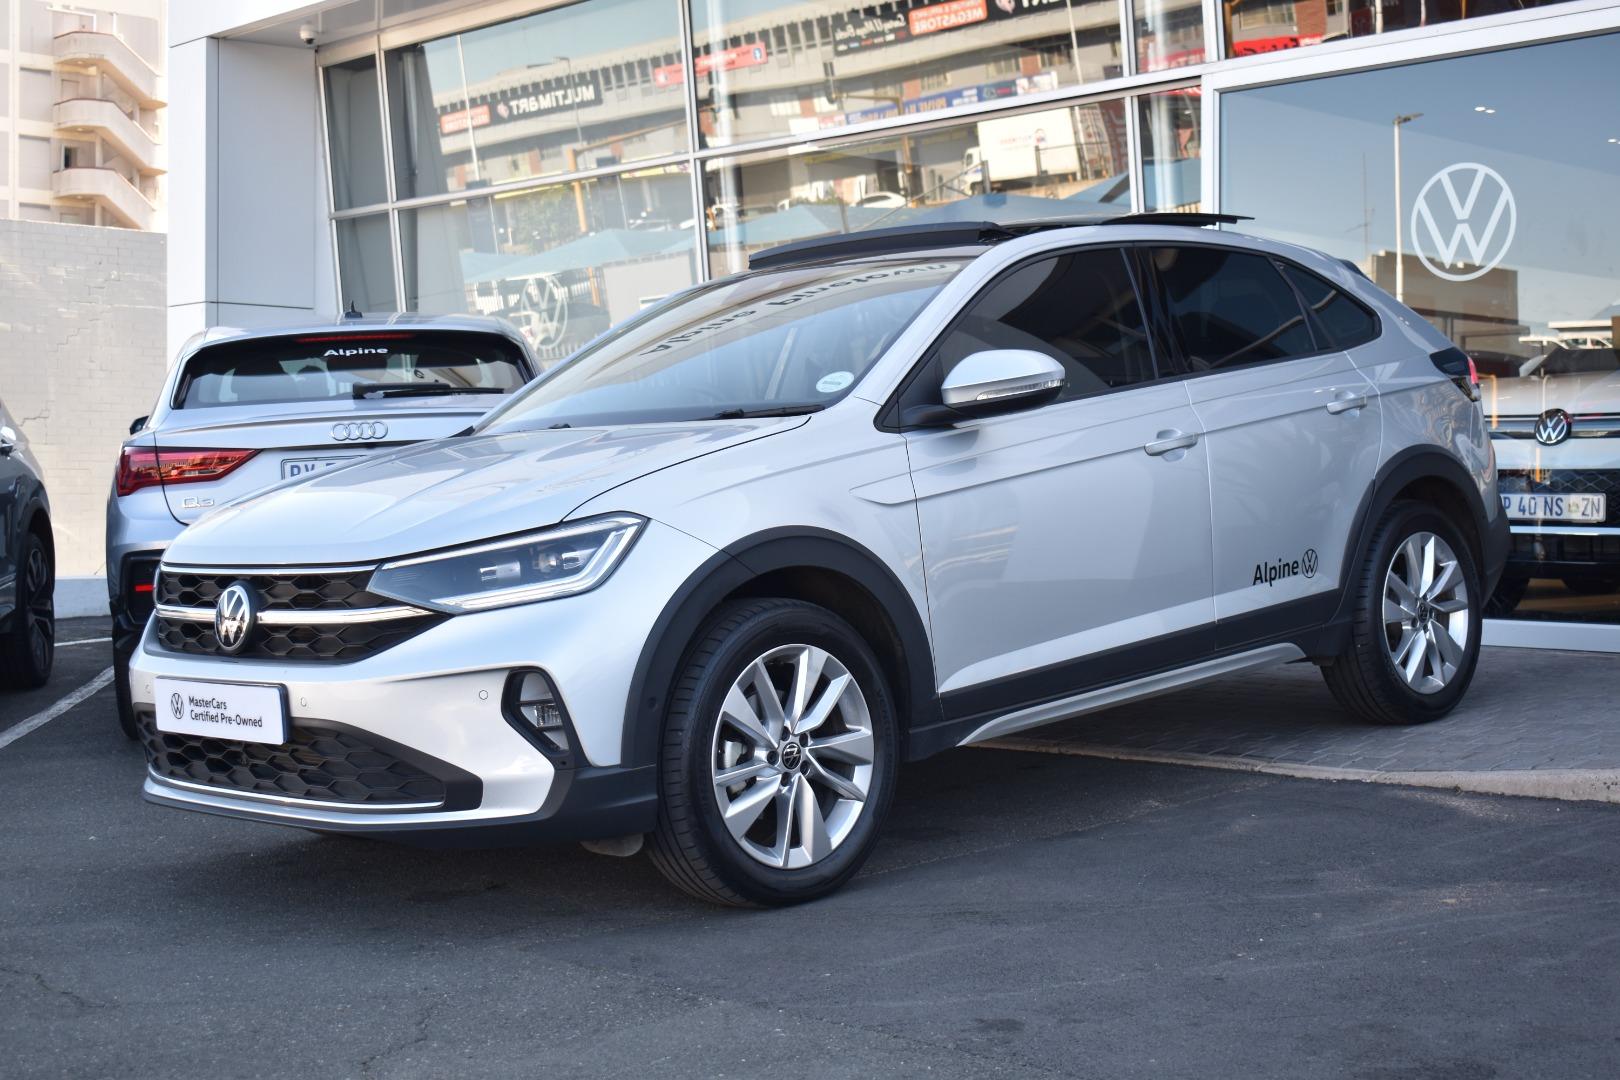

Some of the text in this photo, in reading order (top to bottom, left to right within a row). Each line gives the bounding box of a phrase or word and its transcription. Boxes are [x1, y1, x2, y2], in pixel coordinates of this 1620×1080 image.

[323, 347, 389, 357] Alpine
[182, 496, 216, 509] Q3
[1518, 496, 1537, 516] 40
[1543, 496, 1564, 517] NS
[1581, 497, 1601, 517] ZN
[1252, 558, 1300, 588] Alpine
[188, 695, 228, 710] MasterCars
[190, 709, 263, 728] Certified Pre-Owned
